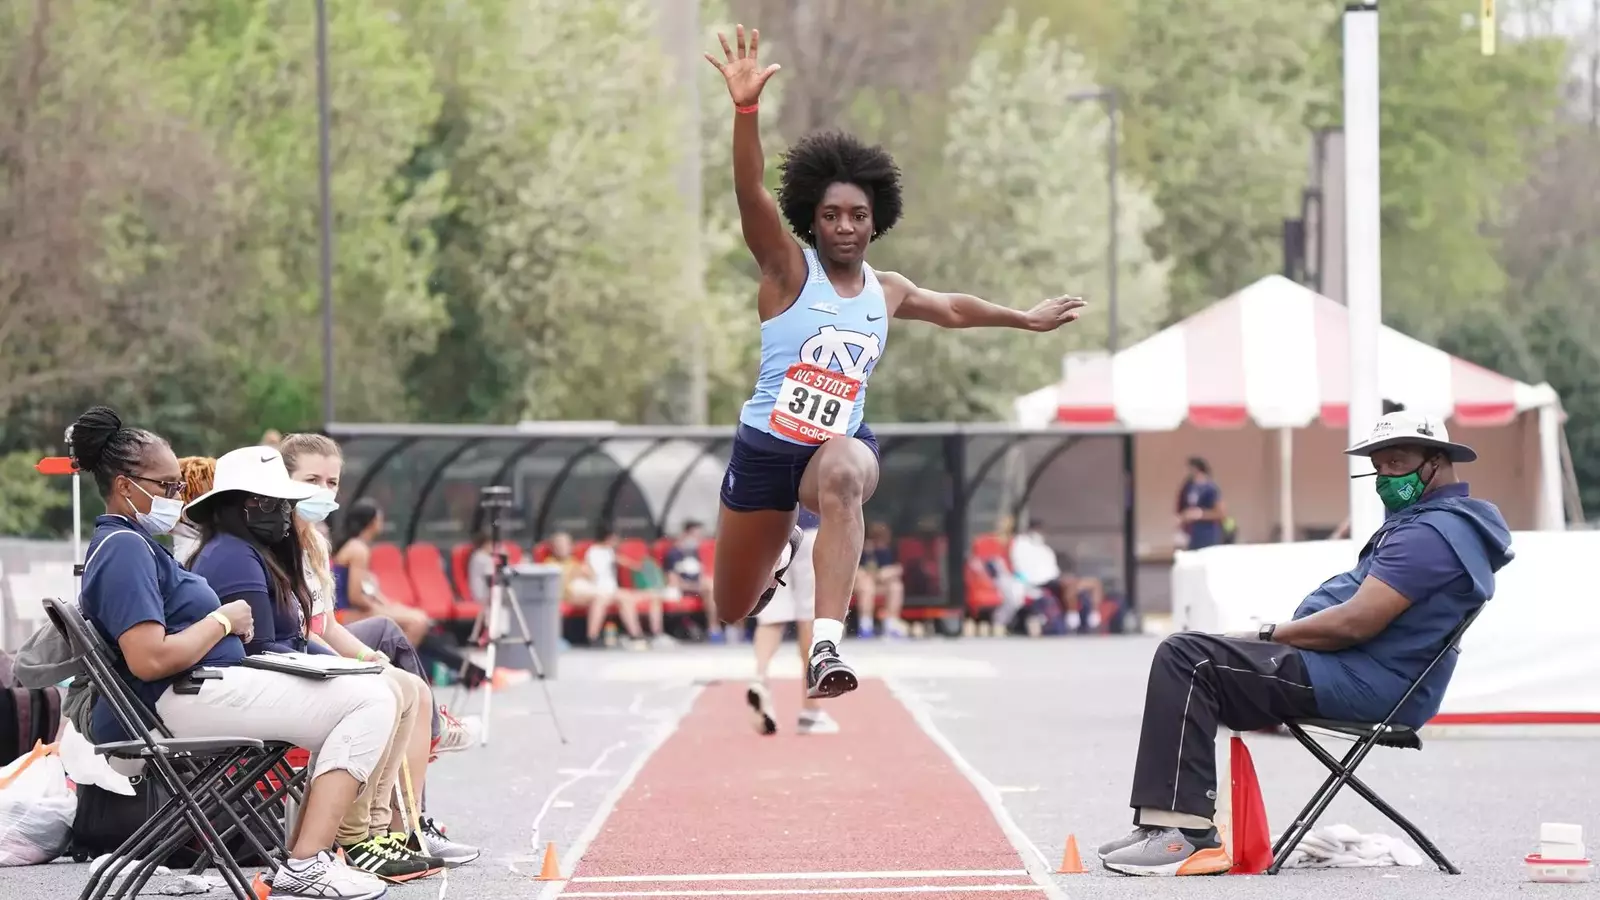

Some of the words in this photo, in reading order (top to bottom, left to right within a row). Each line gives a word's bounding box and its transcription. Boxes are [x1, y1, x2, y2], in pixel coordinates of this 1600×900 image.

[793, 369, 813, 383] NC
[814, 375, 852, 397] STATE
[788, 387, 841, 427] 319
[800, 425, 833, 441] adida
